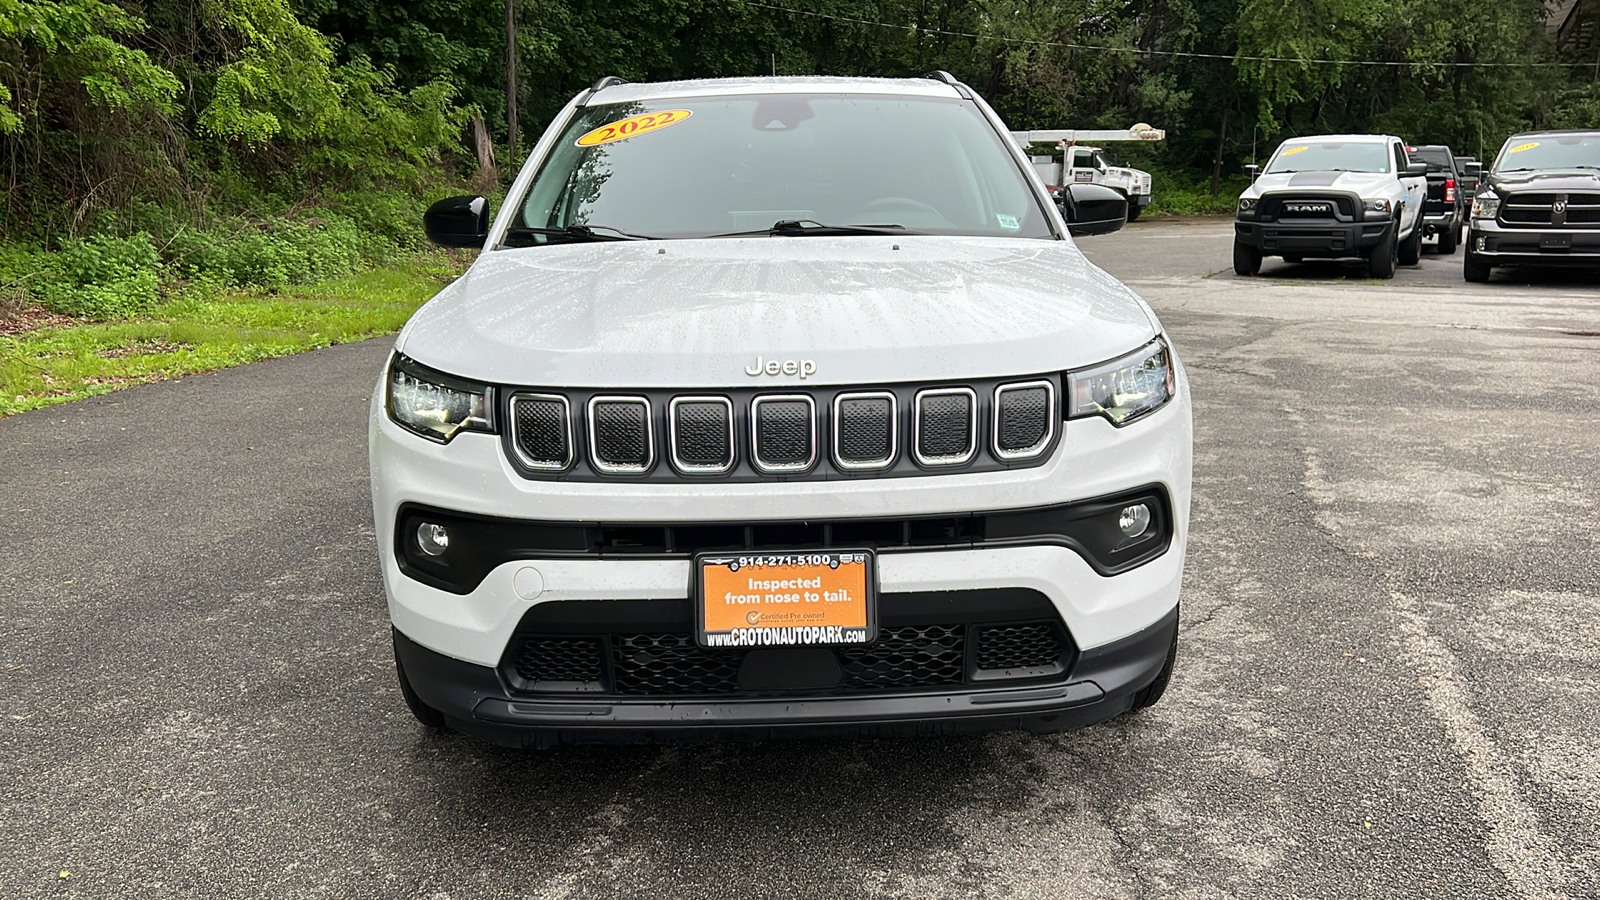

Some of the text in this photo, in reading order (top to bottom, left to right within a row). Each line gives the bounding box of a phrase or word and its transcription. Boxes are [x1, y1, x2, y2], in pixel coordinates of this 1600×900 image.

[599, 112, 675, 141] 2022
[744, 355, 817, 380] Jeep
[738, 555, 831, 567] 914-271-5100
[748, 576, 821, 592] Inspected
[724, 589, 852, 605] from nose to tail.
[760, 612, 789, 620] Certified
